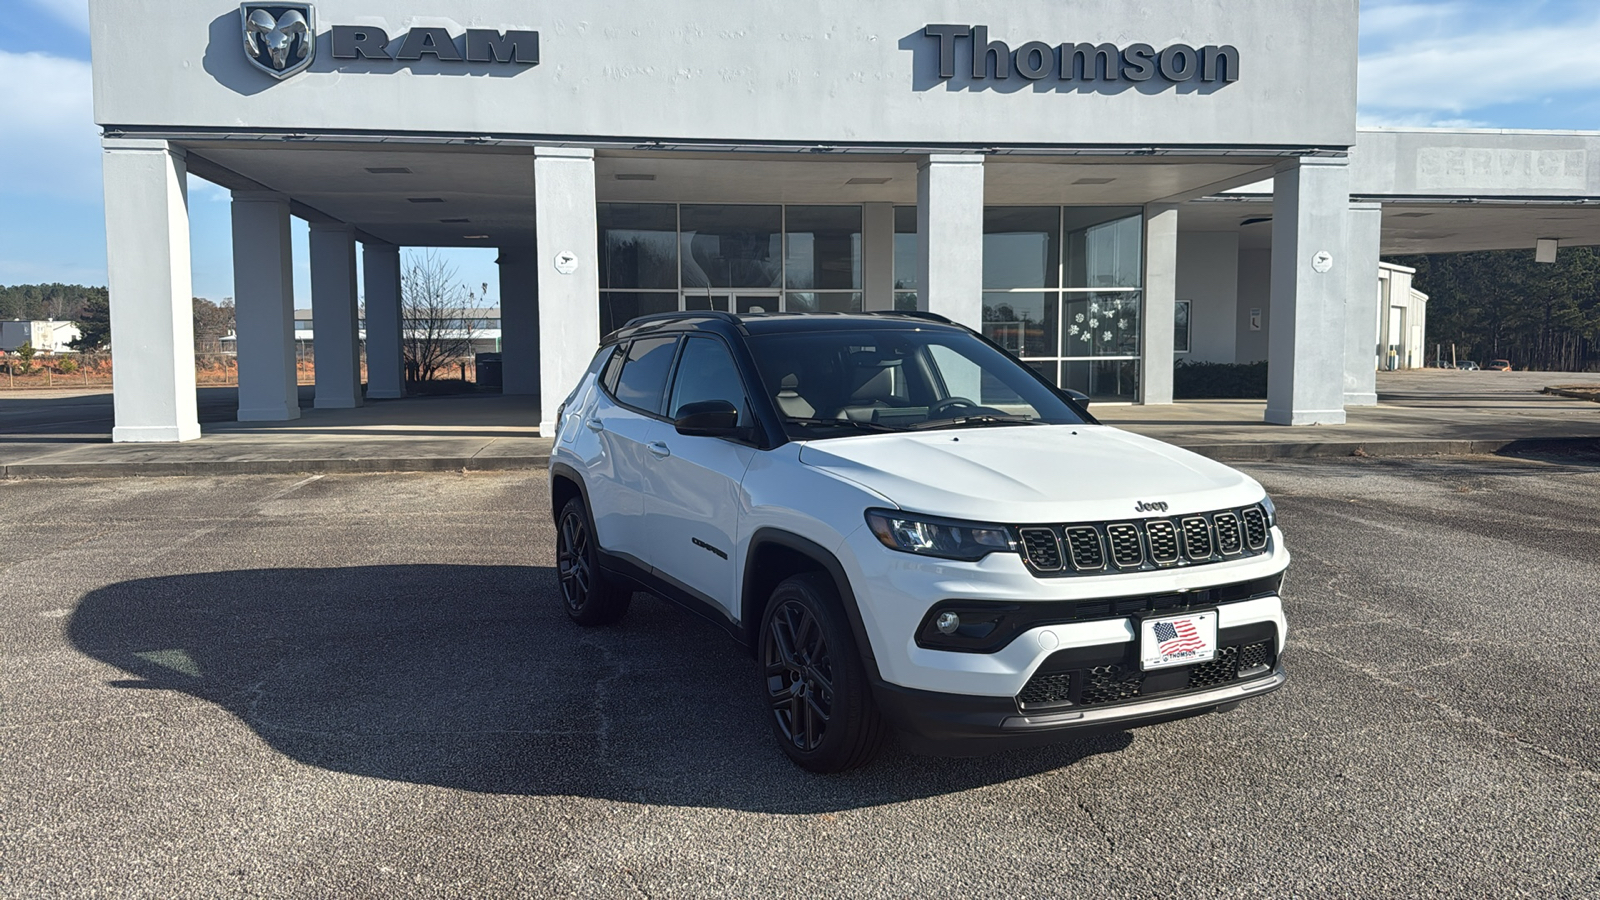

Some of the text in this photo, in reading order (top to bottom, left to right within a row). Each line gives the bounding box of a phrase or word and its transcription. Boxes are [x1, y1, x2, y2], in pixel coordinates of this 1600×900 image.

[331, 25, 539, 64] RAM
[924, 24, 1239, 82] Thomson
[1420, 149, 1584, 177] SERVICE
[1135, 500, 1169, 513] Jeep
[1169, 650, 1196, 659] THOMSON
